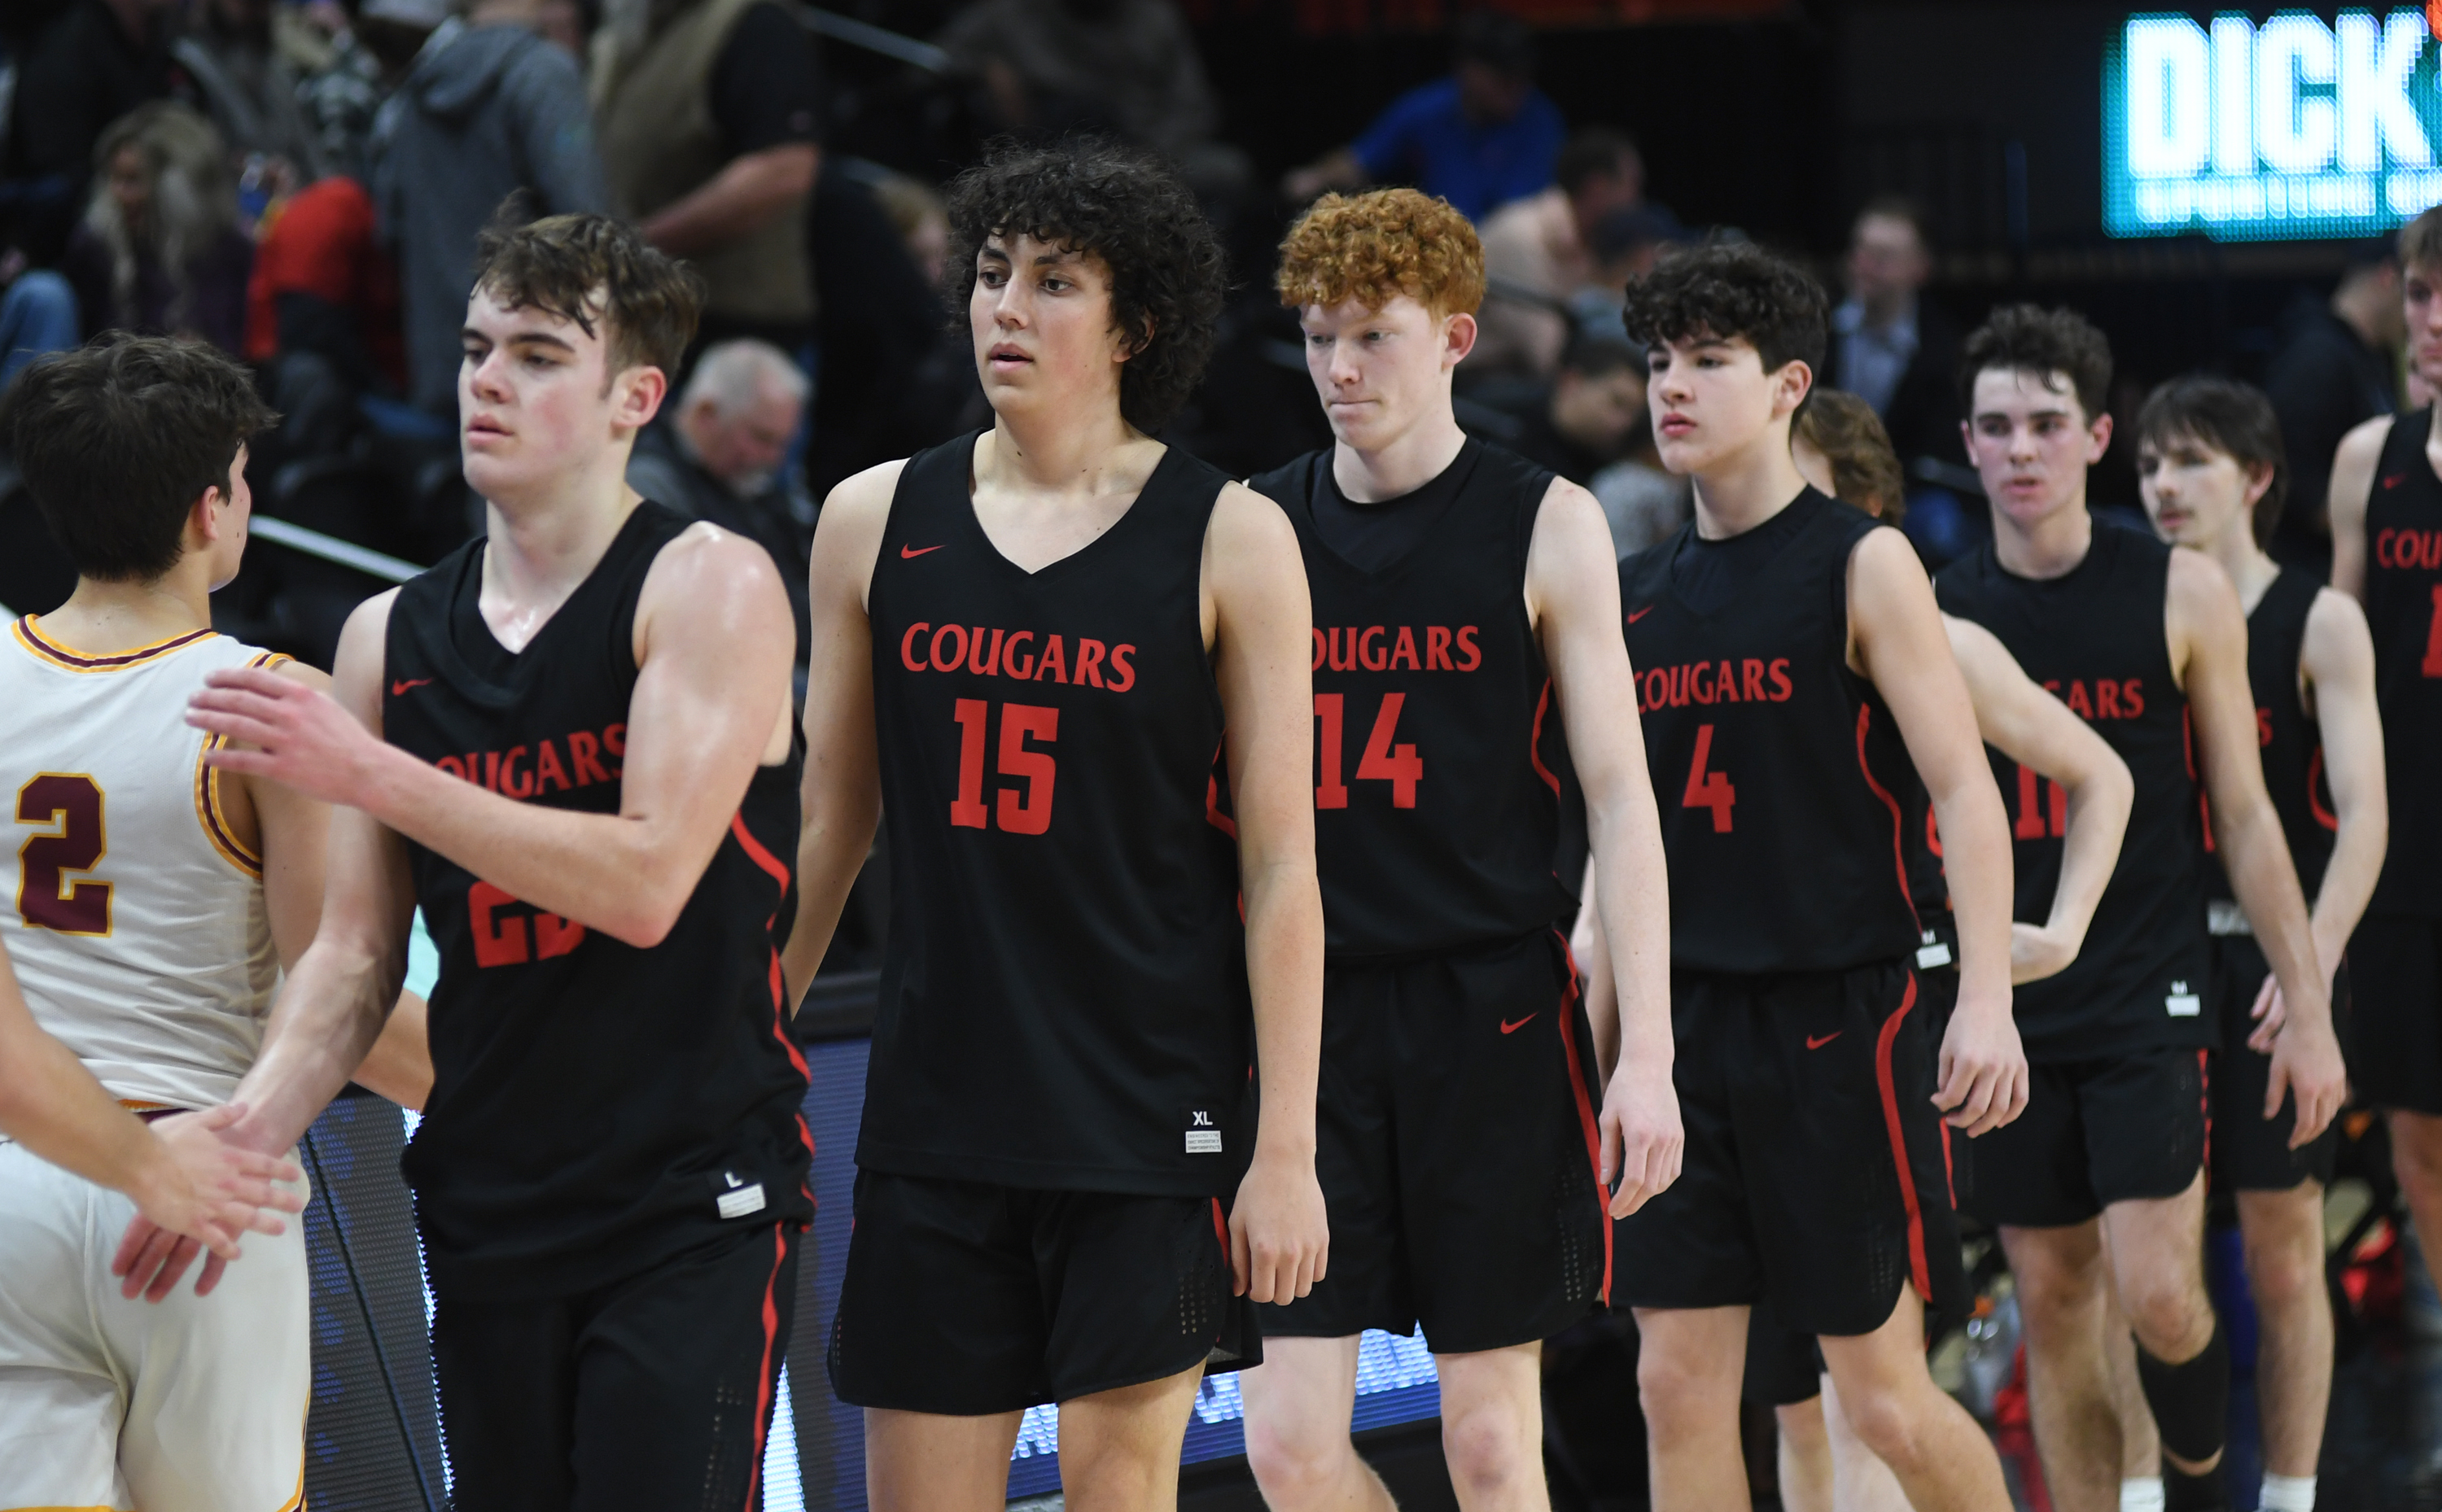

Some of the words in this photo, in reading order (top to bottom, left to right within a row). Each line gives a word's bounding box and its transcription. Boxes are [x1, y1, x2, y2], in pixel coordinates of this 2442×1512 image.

[2126, 11, 2442, 181] DICK
[901, 622, 1136, 693] COUGARS
[951, 697, 1060, 836] 15
[1314, 693, 1424, 810] 14
[1682, 723, 1736, 834] 4
[15, 771, 115, 937] 2
[1192, 1110, 1214, 1126] XL
[724, 1170, 745, 1189] L
